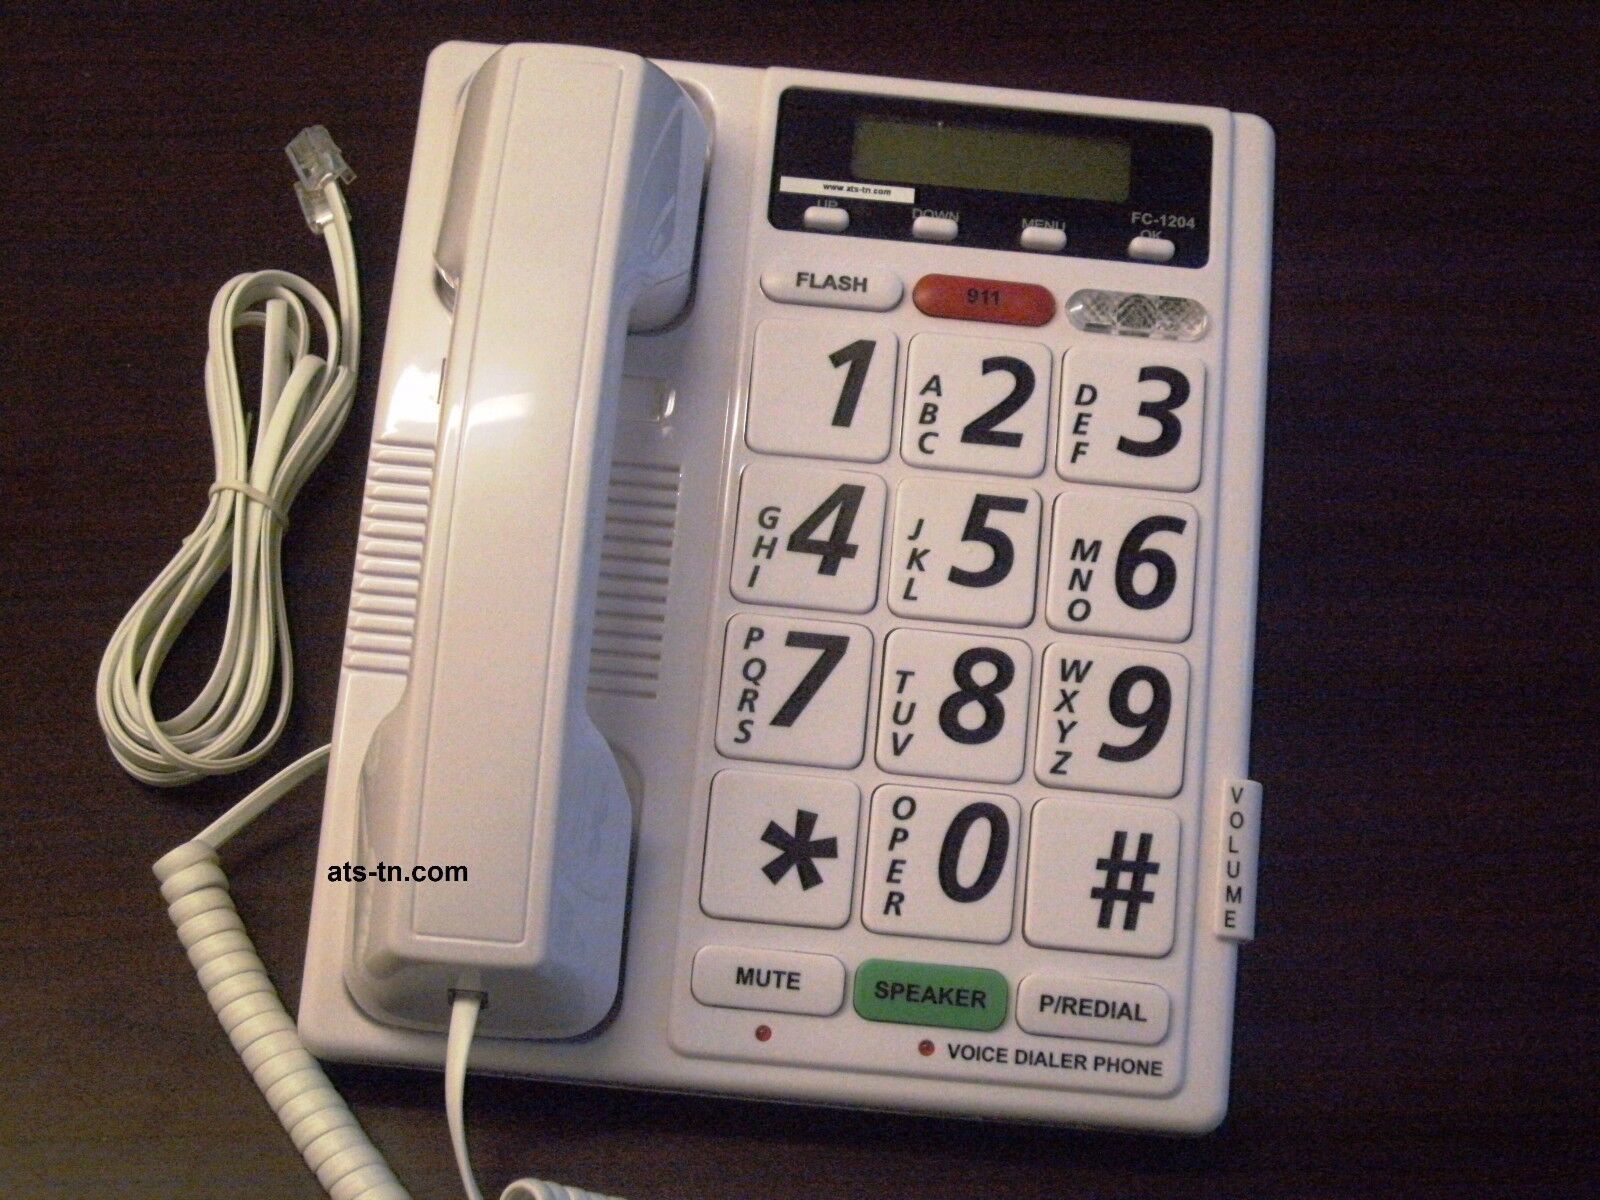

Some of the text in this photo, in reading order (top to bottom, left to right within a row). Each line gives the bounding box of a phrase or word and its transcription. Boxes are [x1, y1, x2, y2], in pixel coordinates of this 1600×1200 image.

[1131, 211, 1196, 230] FC-1204
[796, 271, 868, 294] FLASH
[966, 287, 1000, 306] 911
[828, 339, 877, 428] 1
[960, 355, 1036, 449] 2
[1116, 365, 1191, 458] 3
[786, 483, 866, 577] 4
[947, 493, 1029, 589] 5
[1114, 514, 1188, 611] 6
[769, 630, 850, 728] 7
[938, 646, 1015, 746] 8
[1097, 665, 1172, 763] 9
[937, 801, 1010, 904] 0
[1223, 786, 1246, 930] VOLUME
[734, 966, 802, 991] MUTE
[873, 980, 987, 1010] SPEAKER
[1038, 993, 1148, 1023] P/REDIAL
[947, 1043, 1163, 1078] VOICE DIALER PHONE
